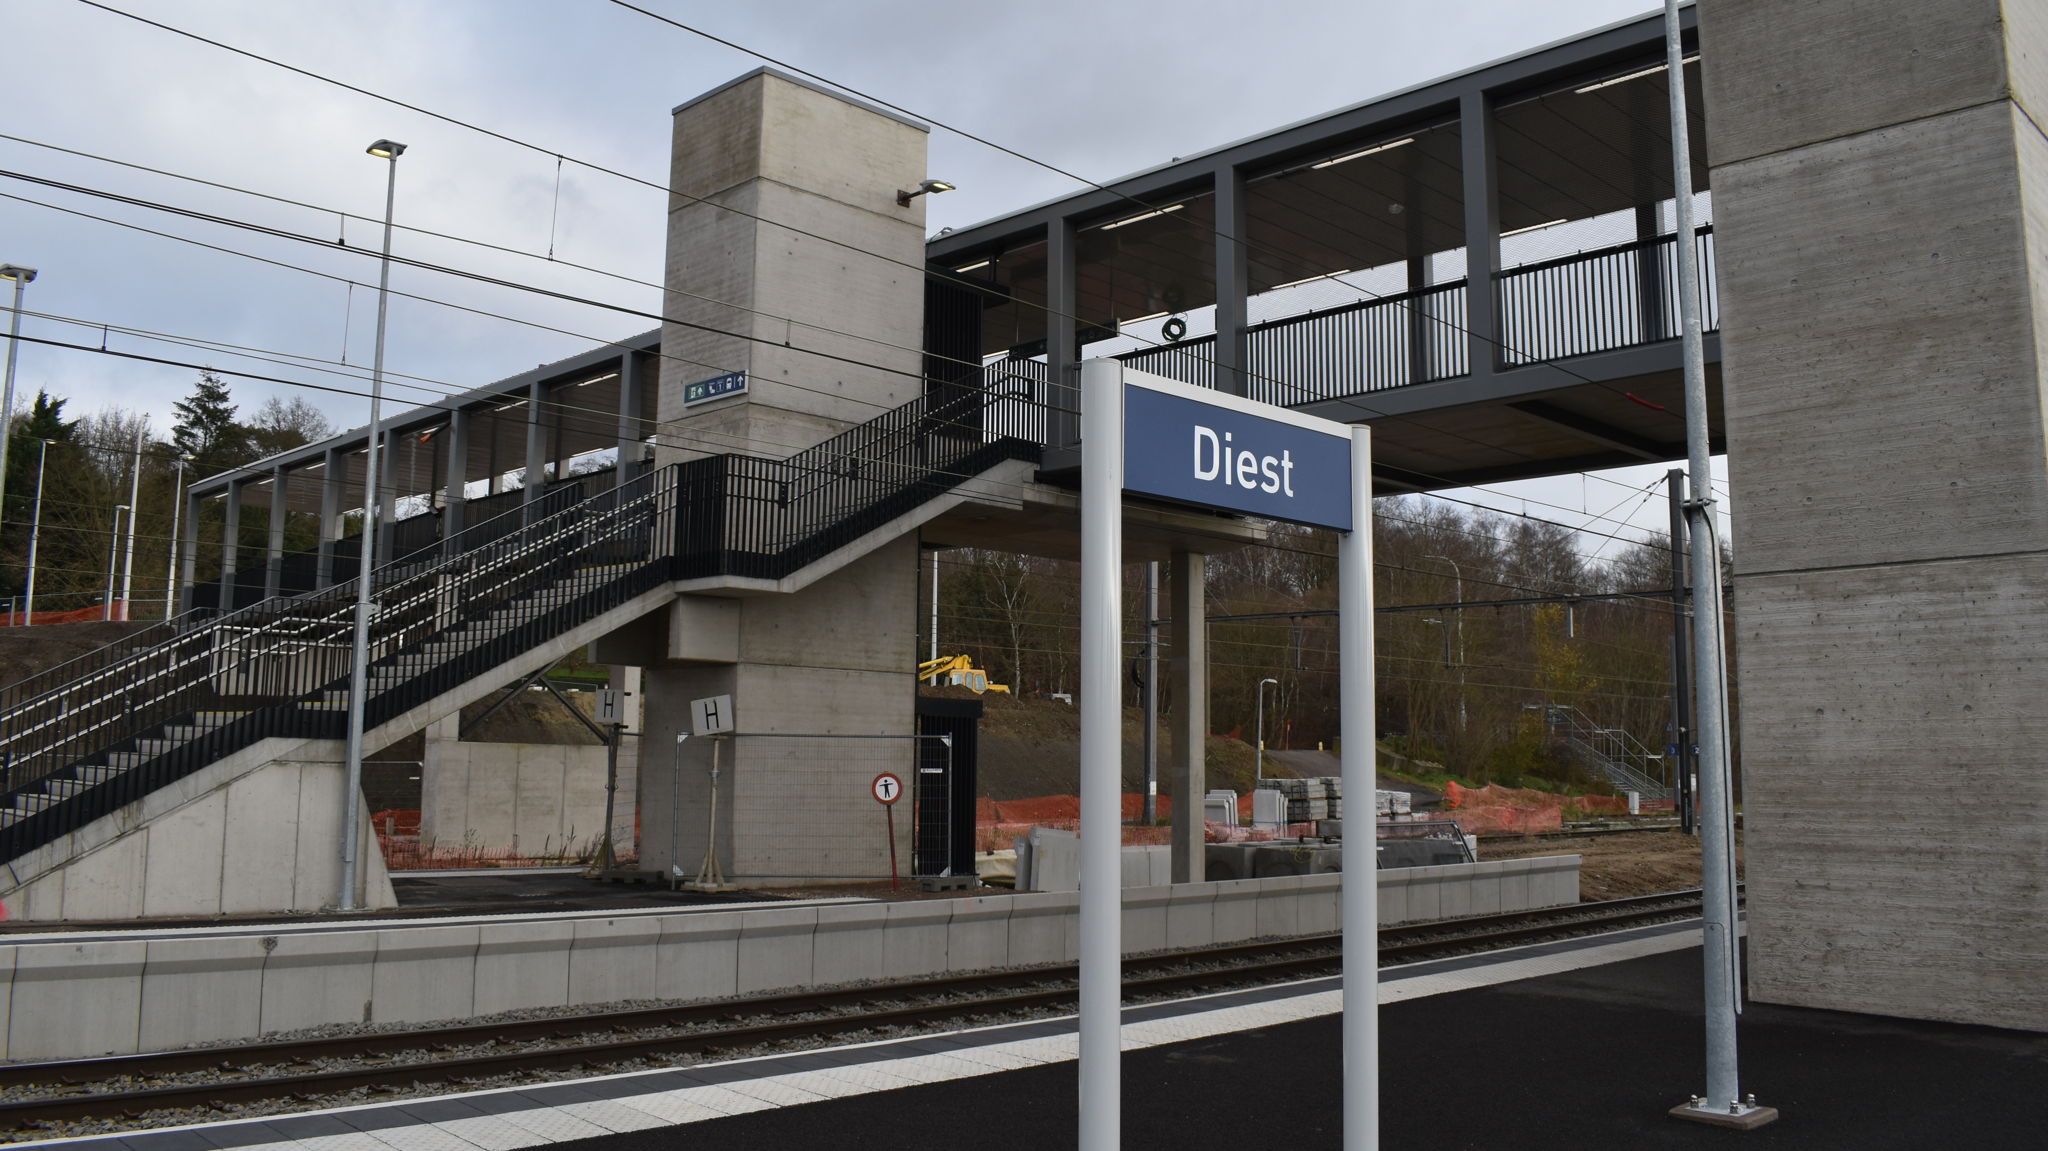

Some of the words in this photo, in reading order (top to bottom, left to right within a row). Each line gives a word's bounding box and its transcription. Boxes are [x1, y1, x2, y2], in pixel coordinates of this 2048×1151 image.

[1194, 425, 1294, 498] Diest
[603, 691, 615, 718] H
[704, 699, 720, 730] H
